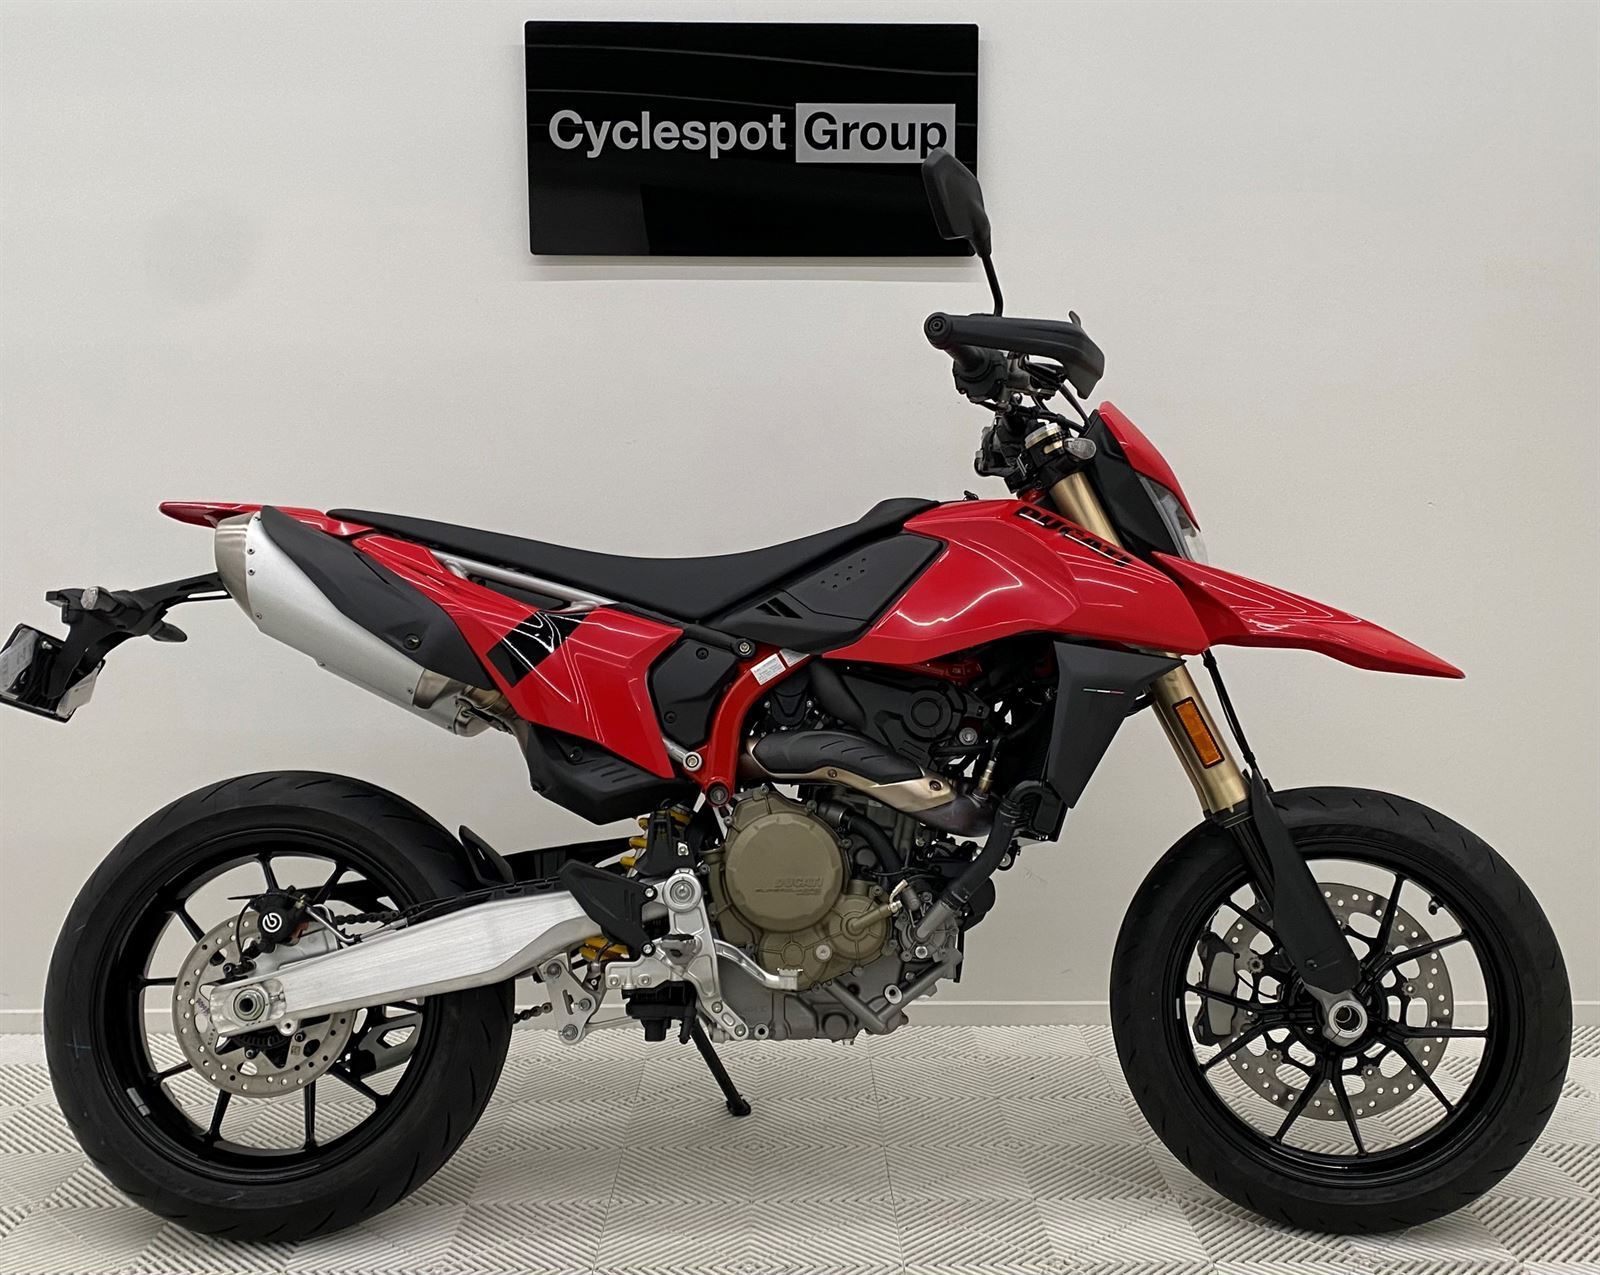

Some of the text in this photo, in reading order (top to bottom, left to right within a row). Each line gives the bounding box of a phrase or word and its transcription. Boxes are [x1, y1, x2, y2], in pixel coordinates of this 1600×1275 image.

[549, 109, 947, 160] Cyclespot Group
[1014, 505, 1132, 568] DUCATI
